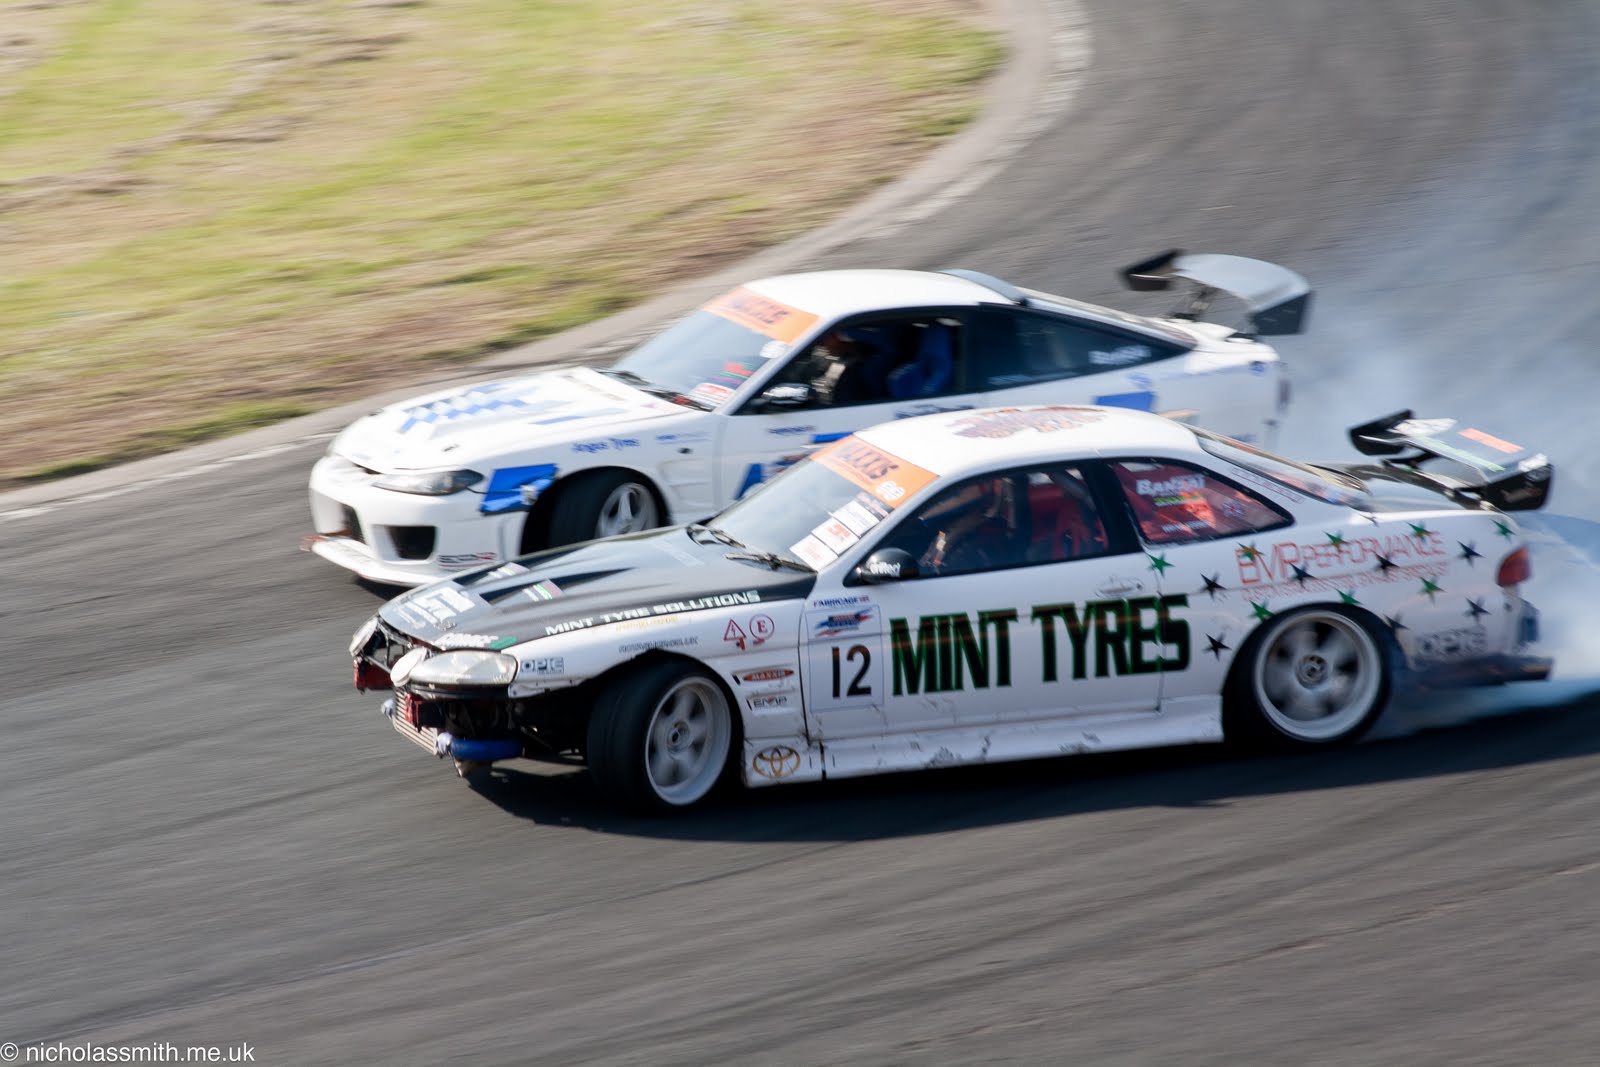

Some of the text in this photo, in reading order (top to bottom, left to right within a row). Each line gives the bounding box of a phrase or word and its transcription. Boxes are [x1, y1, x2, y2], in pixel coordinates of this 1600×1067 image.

[545, 590, 761, 636] MINT TYRE SOLUTIONS
[831, 644, 872, 699] 12
[889, 593, 1191, 696] MINT TYRES
